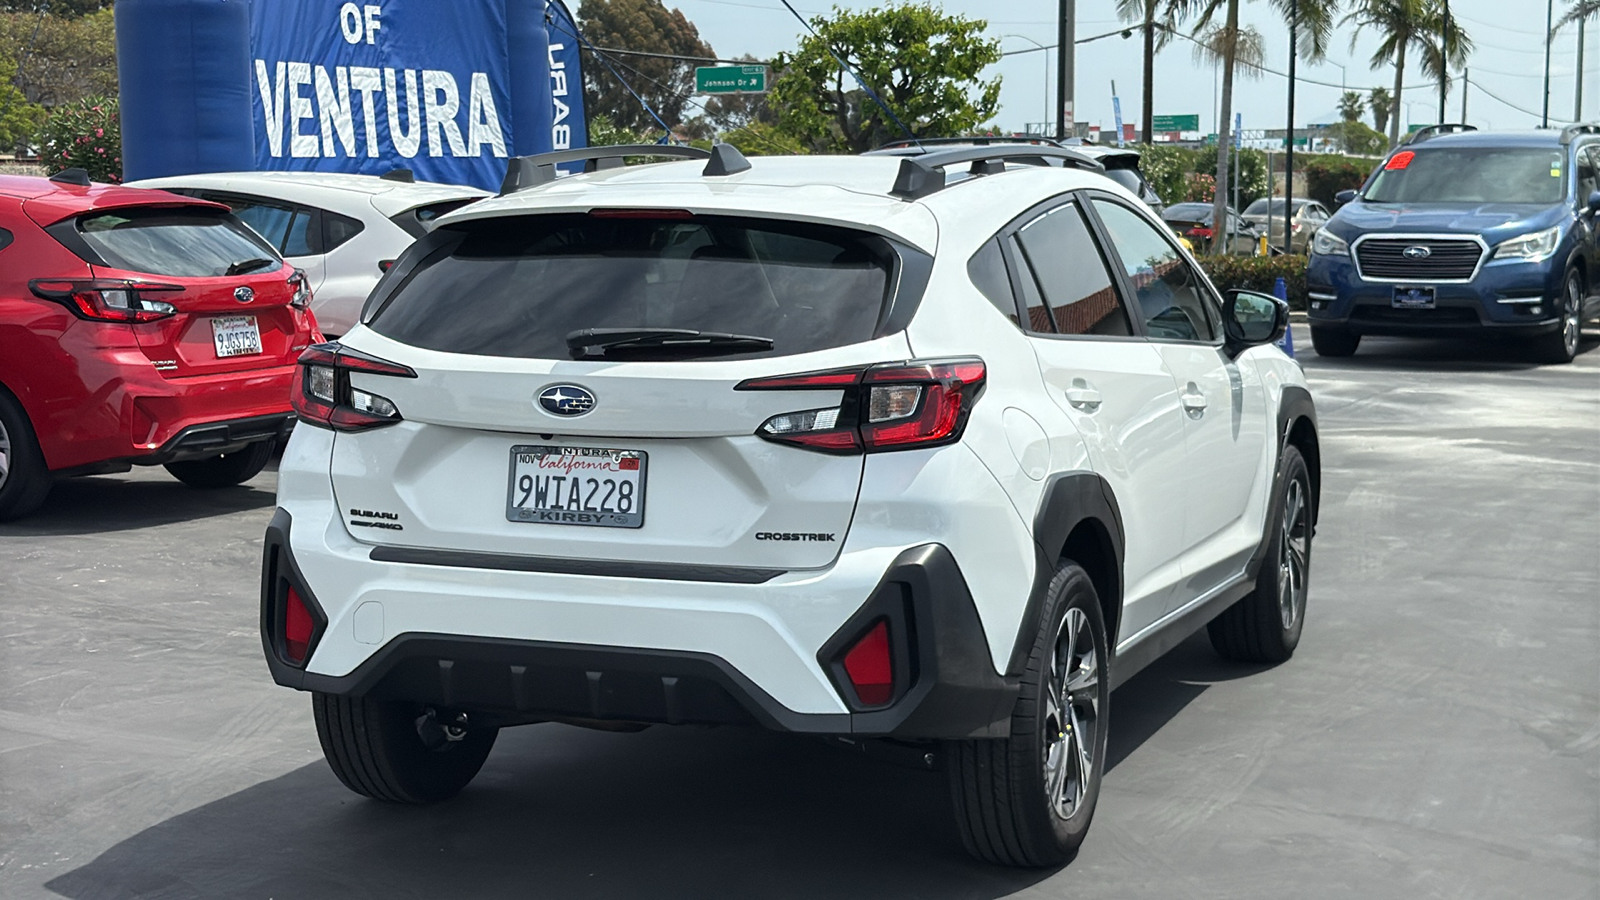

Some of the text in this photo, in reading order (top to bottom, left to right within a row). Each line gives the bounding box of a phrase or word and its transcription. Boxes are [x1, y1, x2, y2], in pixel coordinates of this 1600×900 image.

[340, 2, 381, 45] OF
[255, 59, 508, 158] VENTURA
[217, 331, 258, 350] 9JGS758
[519, 454, 535, 464] NOV
[538, 453, 619, 475] California
[517, 474, 634, 514] 9WIA228
[350, 508, 399, 520] SUBARU
[540, 511, 606, 523] KIRBY
[755, 532, 836, 542] CROSSTREK
